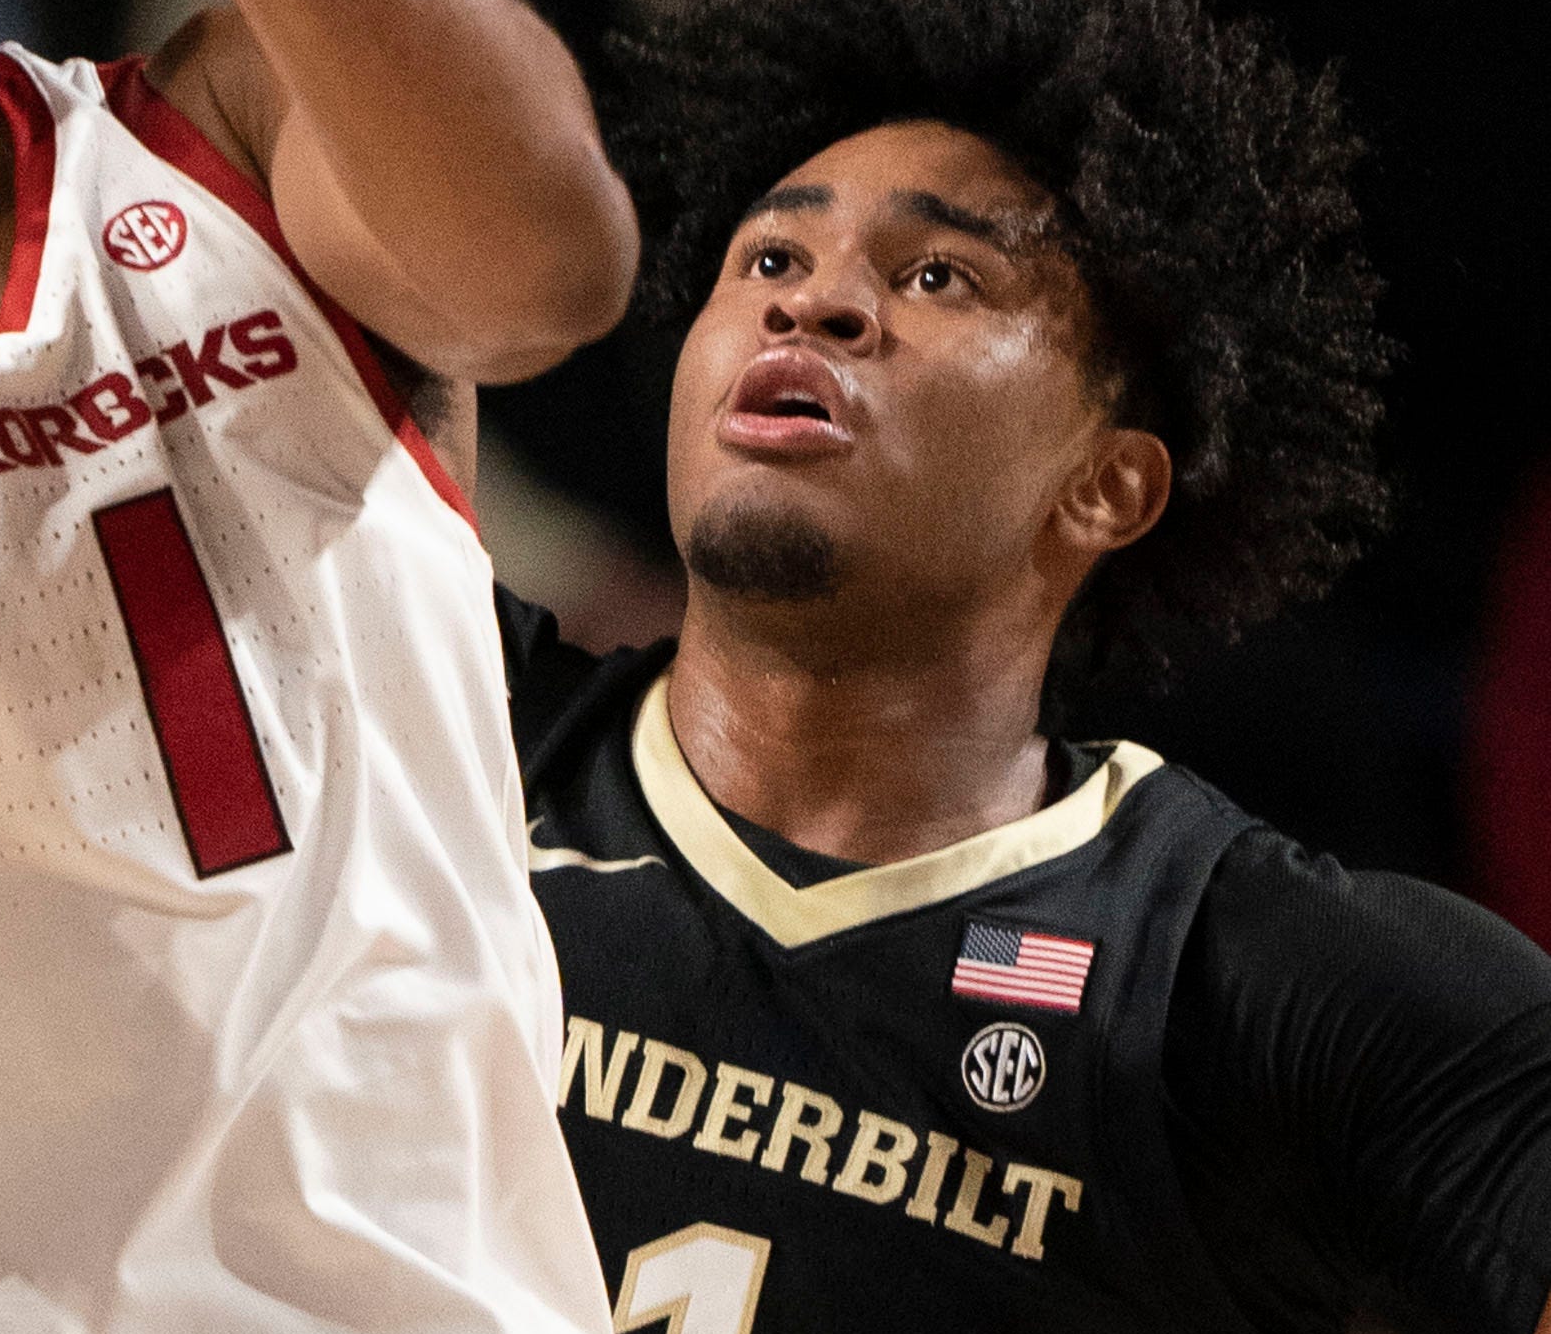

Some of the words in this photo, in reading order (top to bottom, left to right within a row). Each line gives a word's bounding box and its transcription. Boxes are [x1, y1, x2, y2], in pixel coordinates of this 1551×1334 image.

[108, 205, 180, 267] SEC
[91, 486, 294, 880] 1
[558, 1016, 1084, 1262] NDERBILT
[969, 1029, 1039, 1103] SEC
